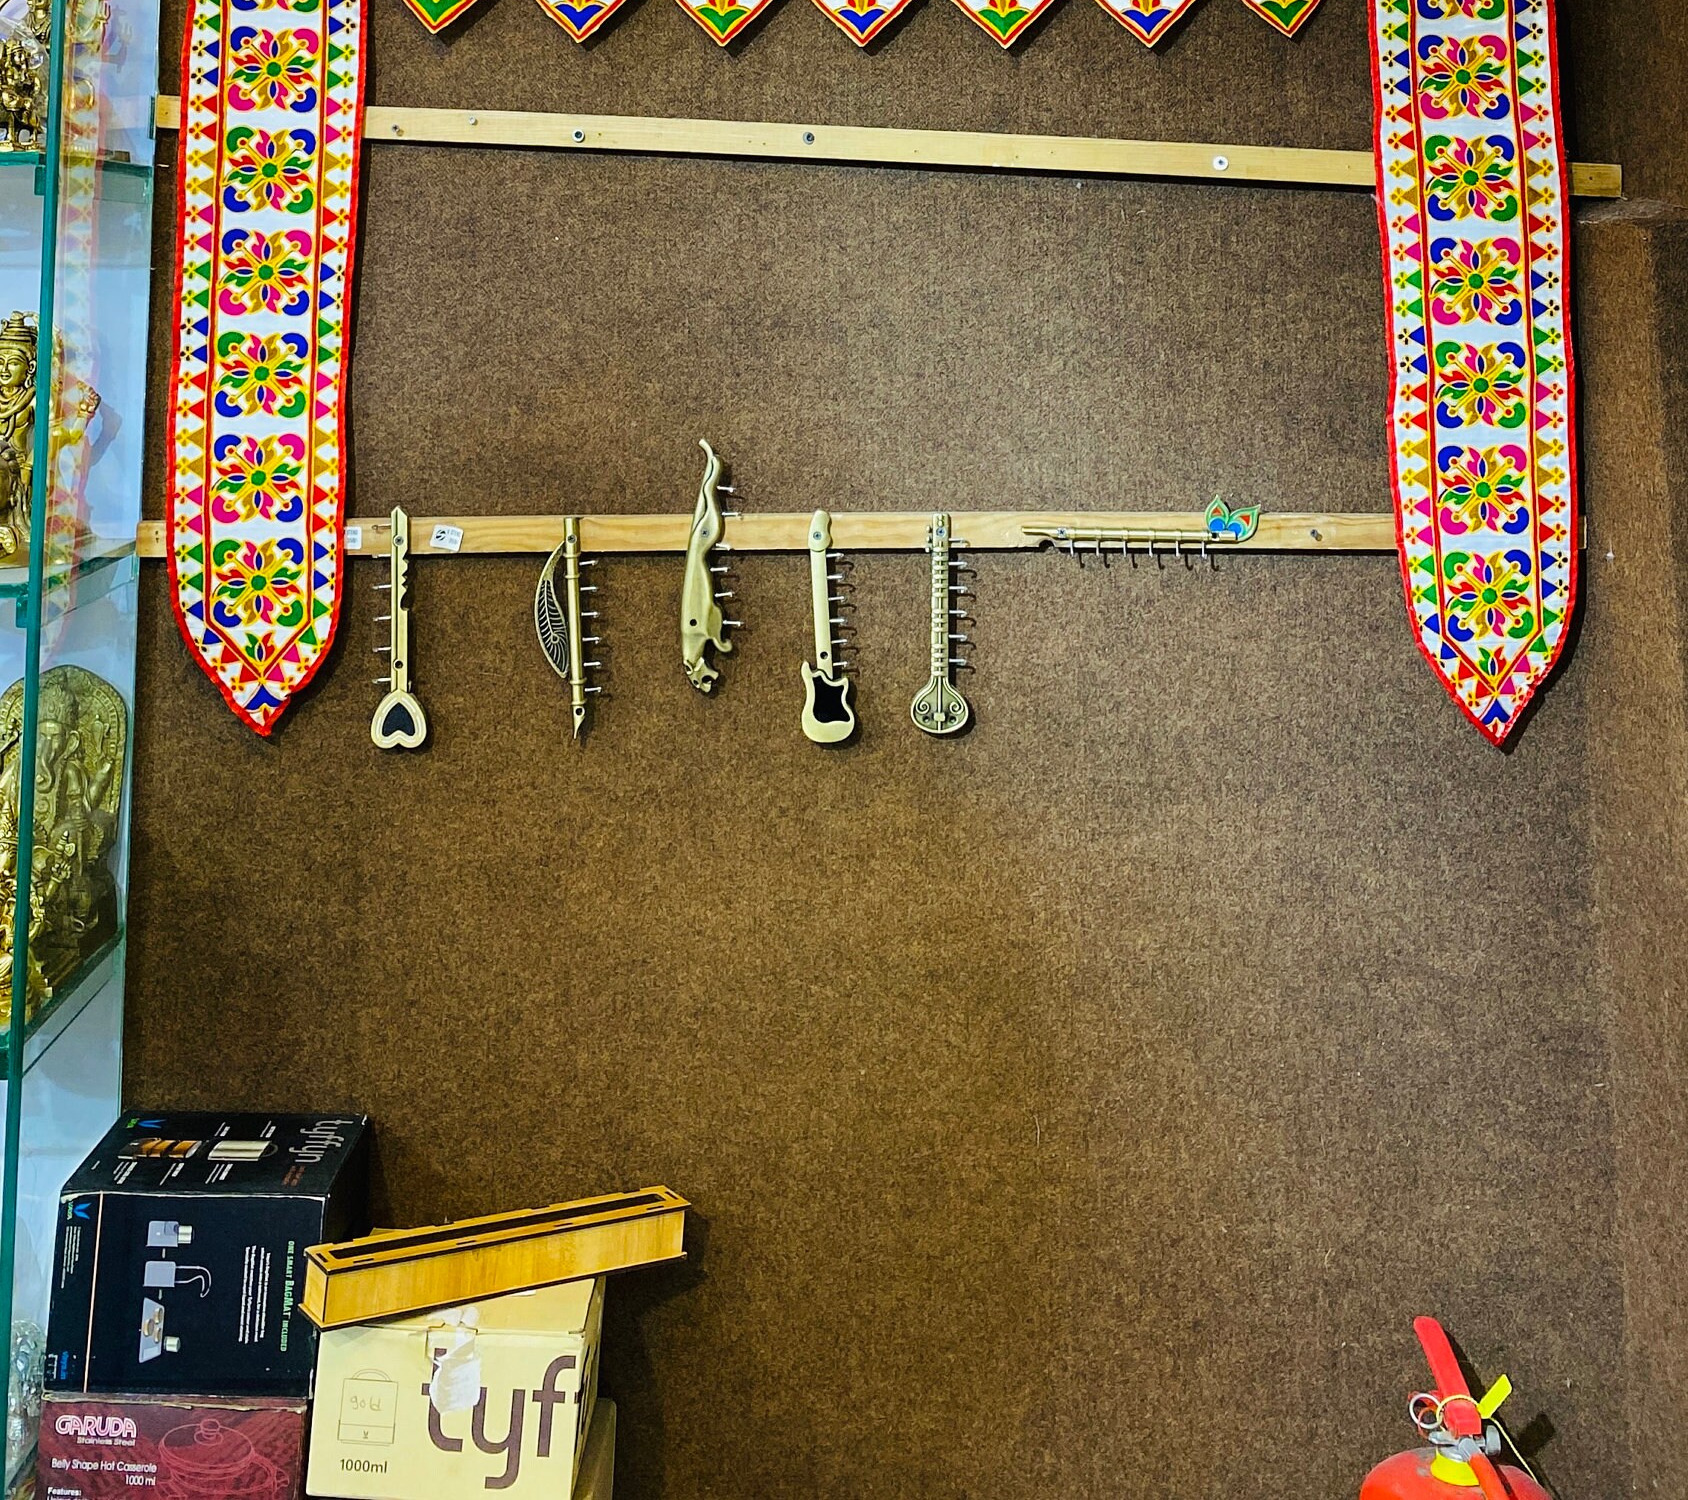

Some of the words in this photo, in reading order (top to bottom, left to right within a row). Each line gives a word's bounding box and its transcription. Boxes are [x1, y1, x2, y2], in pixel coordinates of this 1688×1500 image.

[288, 1119, 354, 1162] tyffyn
[55, 1414, 137, 1438] GARUDA
[421, 1348, 582, 1489] tyf
[113, 1438, 136, 1447] Steel
[51, 1457, 71, 1470] Belly
[71, 1458, 99, 1472] Shape
[100, 1460, 115, 1471] Hot
[117, 1461, 158, 1473] Casserole
[340, 1458, 388, 1474] 1000ml
[125, 1474, 144, 1486] 1000
[145, 1476, 157, 1486] ml
[47, 1486, 82, 1496] Features:
